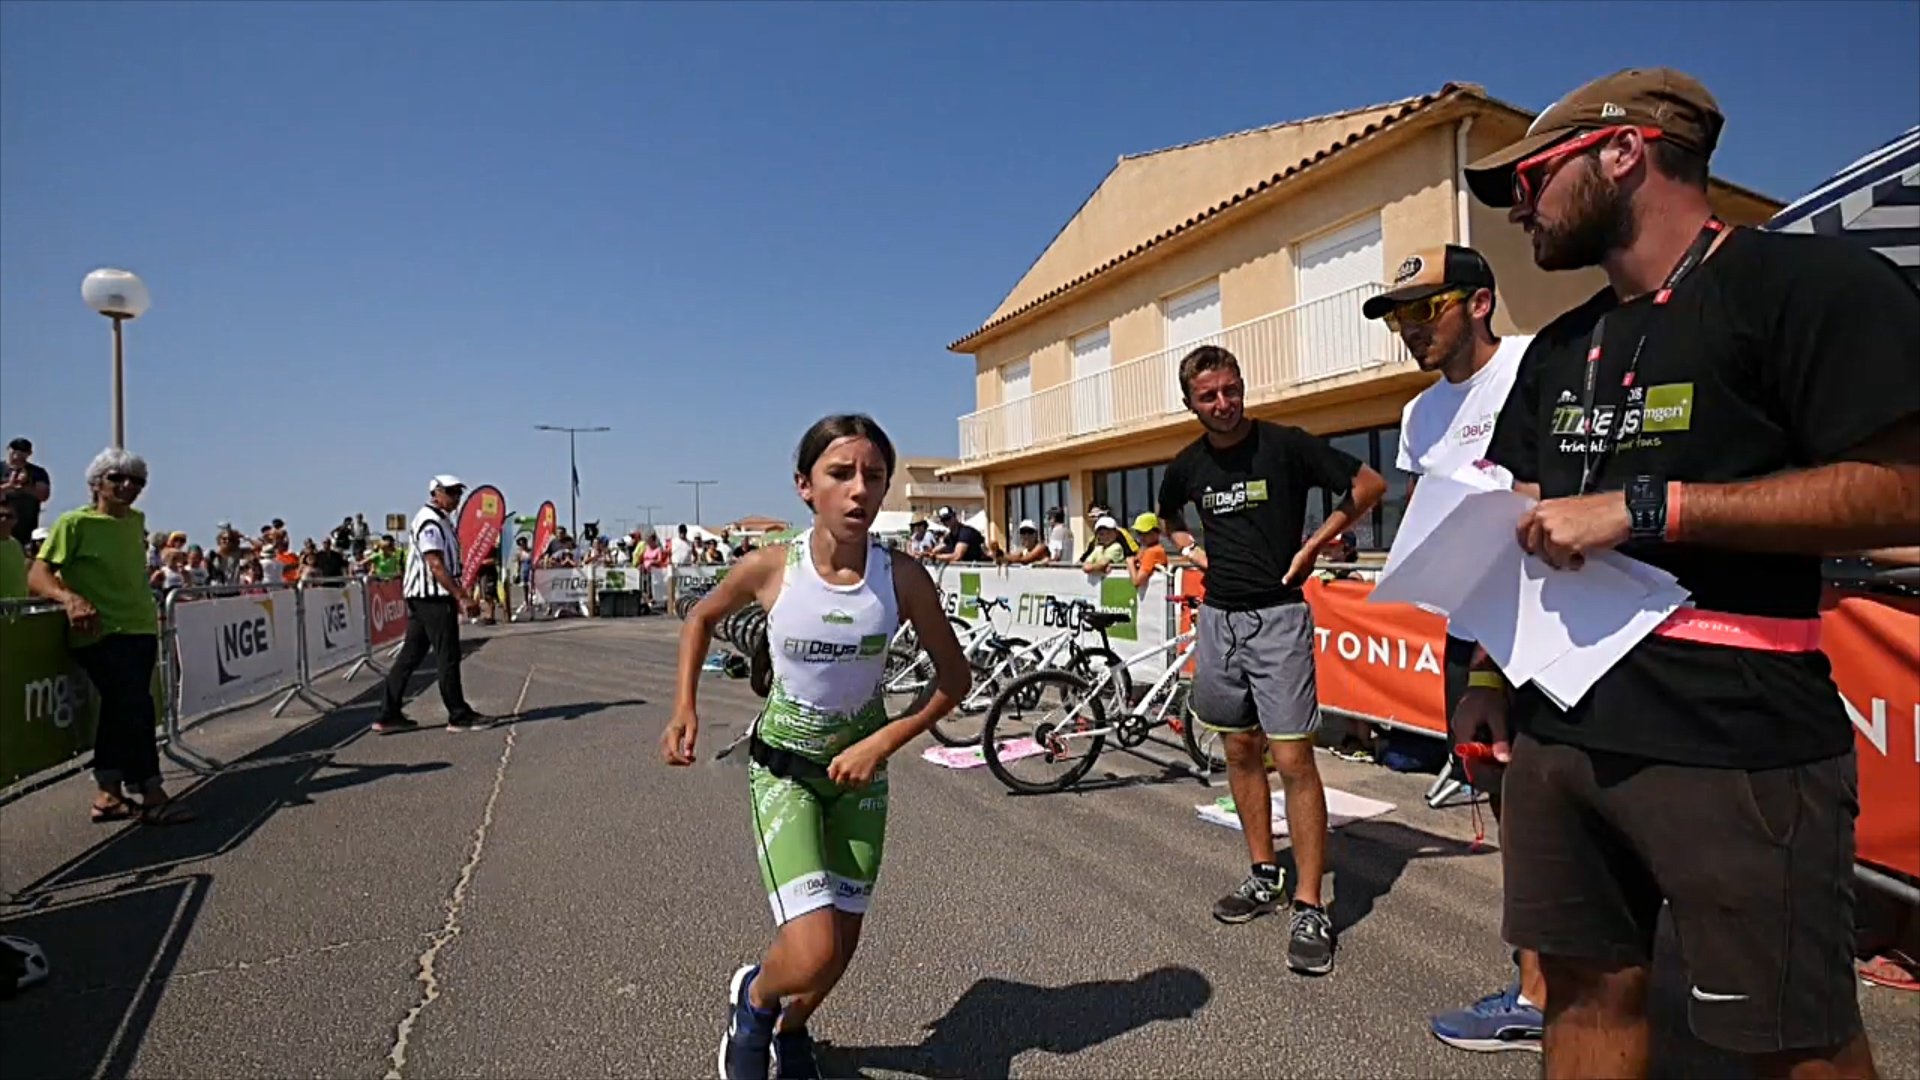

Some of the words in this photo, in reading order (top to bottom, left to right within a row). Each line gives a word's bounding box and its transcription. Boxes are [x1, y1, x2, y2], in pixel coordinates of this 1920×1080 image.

[1643, 404, 1683, 422] mgen
[223, 616, 269, 662] NGE
[25, 674, 74, 728] mg
